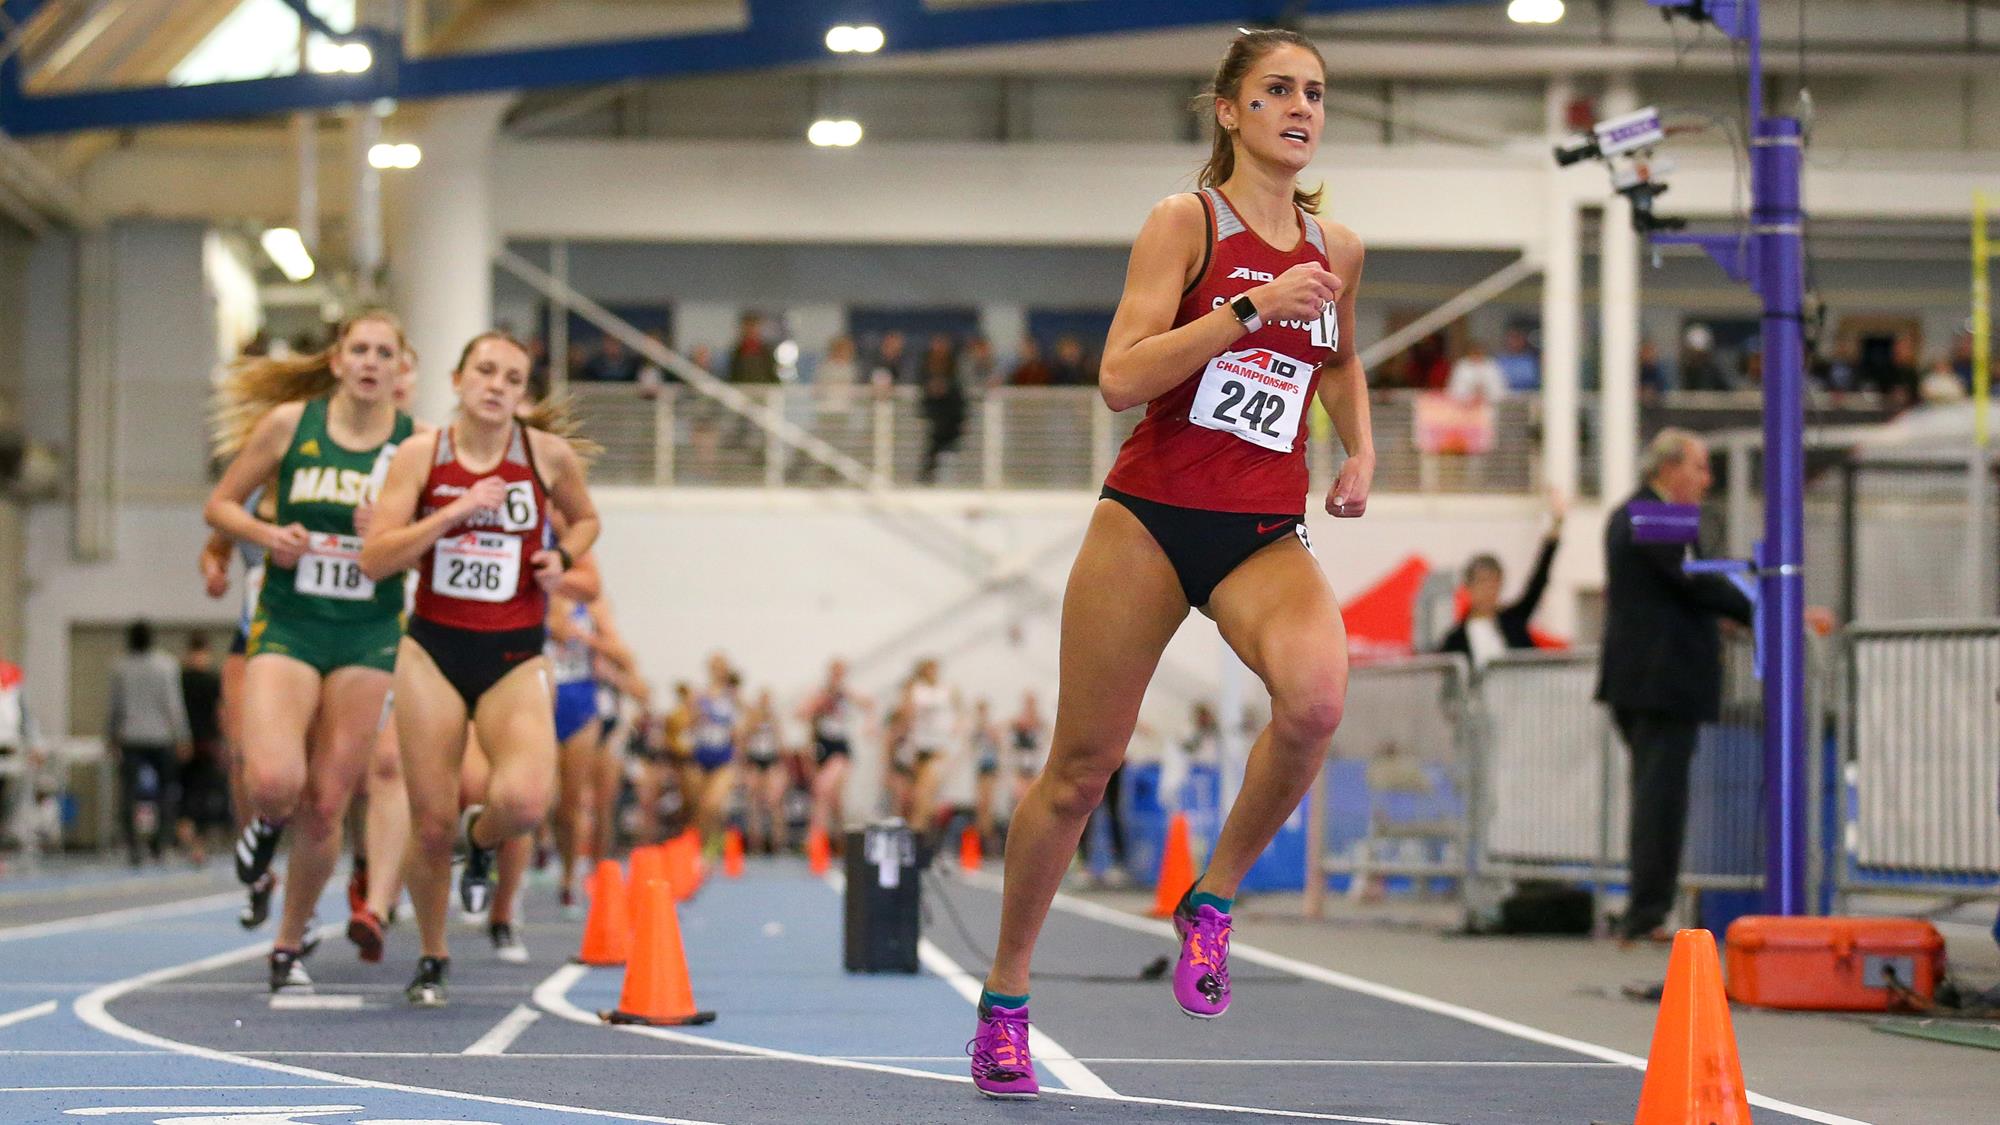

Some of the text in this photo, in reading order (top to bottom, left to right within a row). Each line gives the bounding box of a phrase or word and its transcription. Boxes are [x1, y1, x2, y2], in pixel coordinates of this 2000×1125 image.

[1227, 266, 1274, 282] A10
[1216, 360, 1300, 395] CHAMPIONSHIPS
[1236, 350, 1297, 378] A10
[1212, 380, 1286, 438] 242
[506, 487, 529, 525] 6
[315, 561, 361, 590] 118
[449, 559, 500, 591] 236
